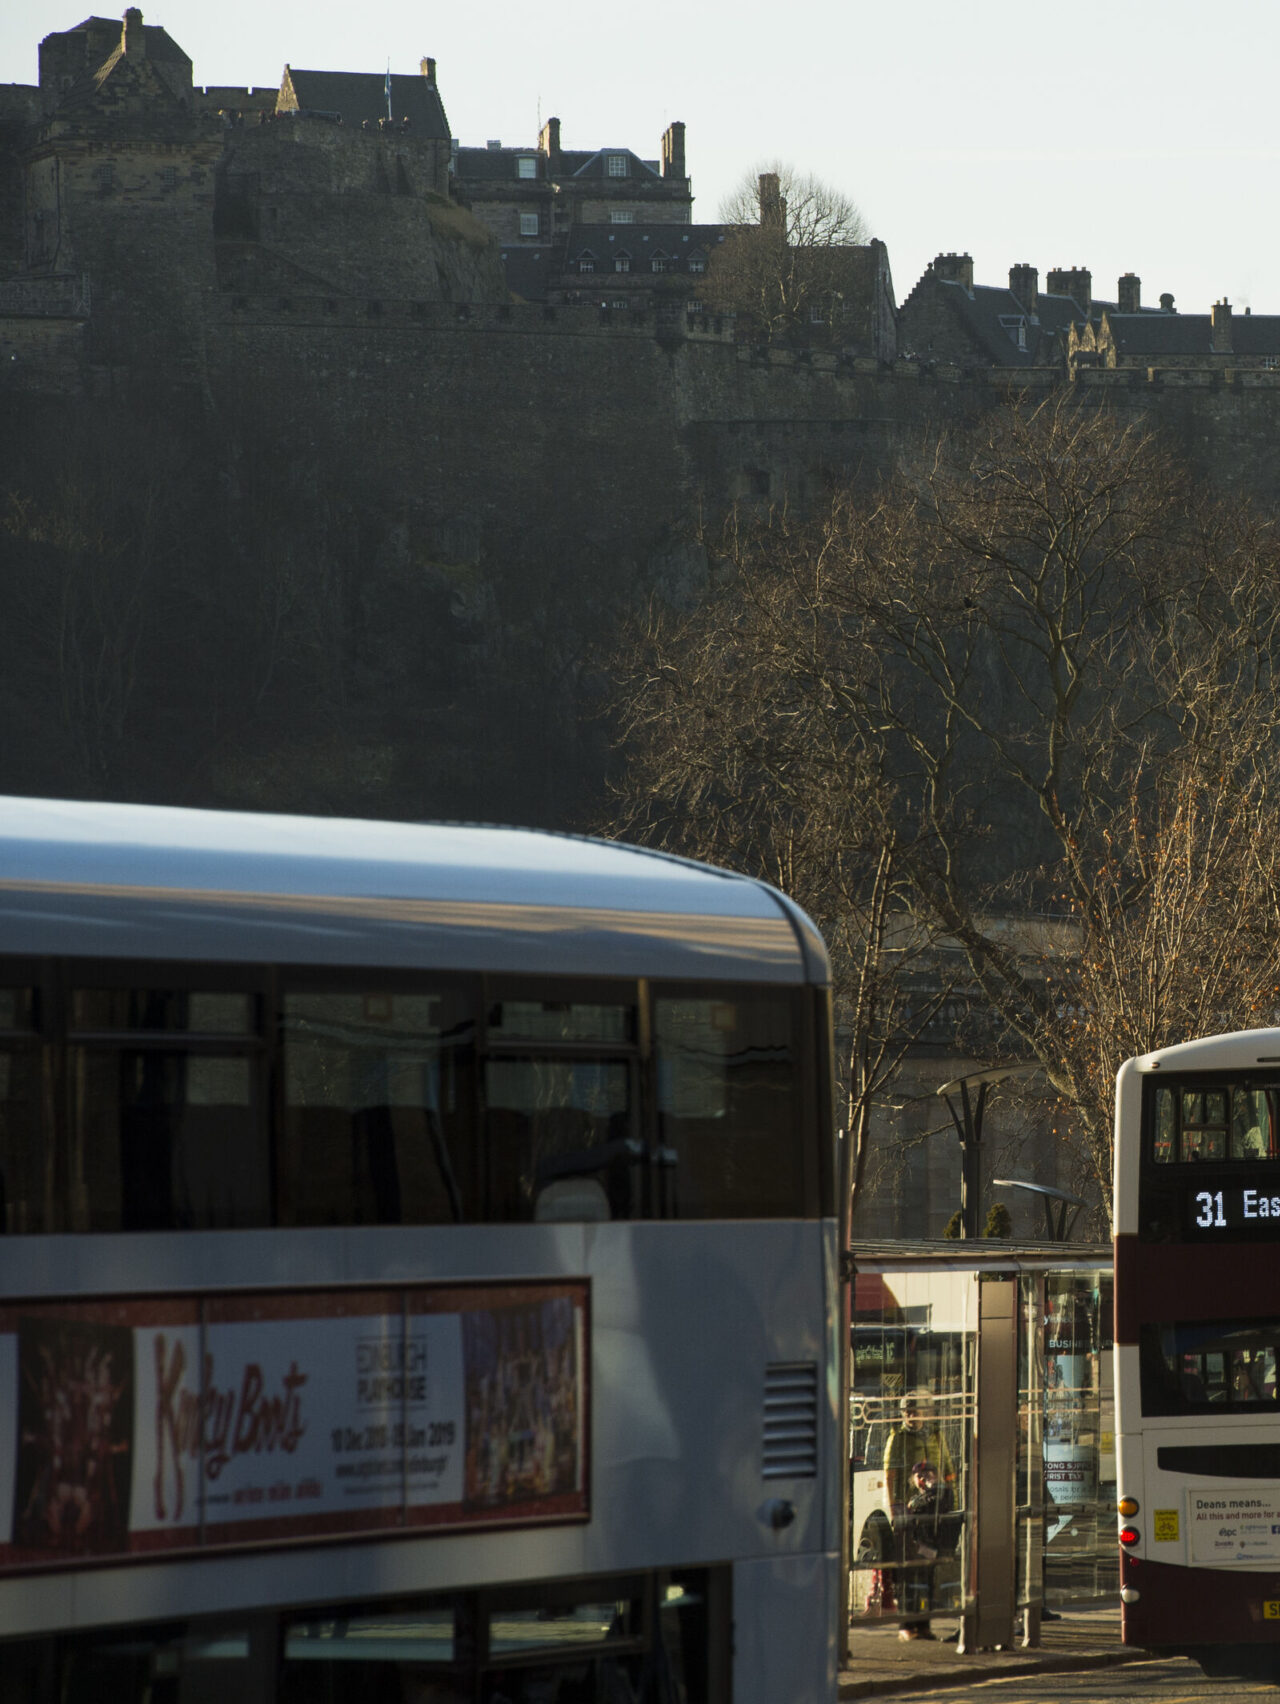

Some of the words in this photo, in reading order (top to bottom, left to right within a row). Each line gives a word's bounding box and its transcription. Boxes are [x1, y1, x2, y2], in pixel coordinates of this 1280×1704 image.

[1196, 1191, 1227, 1227] 31
[232, 1360, 308, 1456] Boots
[1196, 1500, 1226, 1509] Deans
[1229, 1499, 1271, 1509] means...
[1196, 1512, 1207, 1521] All
[1209, 1511, 1224, 1520] this
[1226, 1511, 1240, 1520] and
[1241, 1511, 1262, 1519] more
[1263, 1510, 1275, 1519] for
